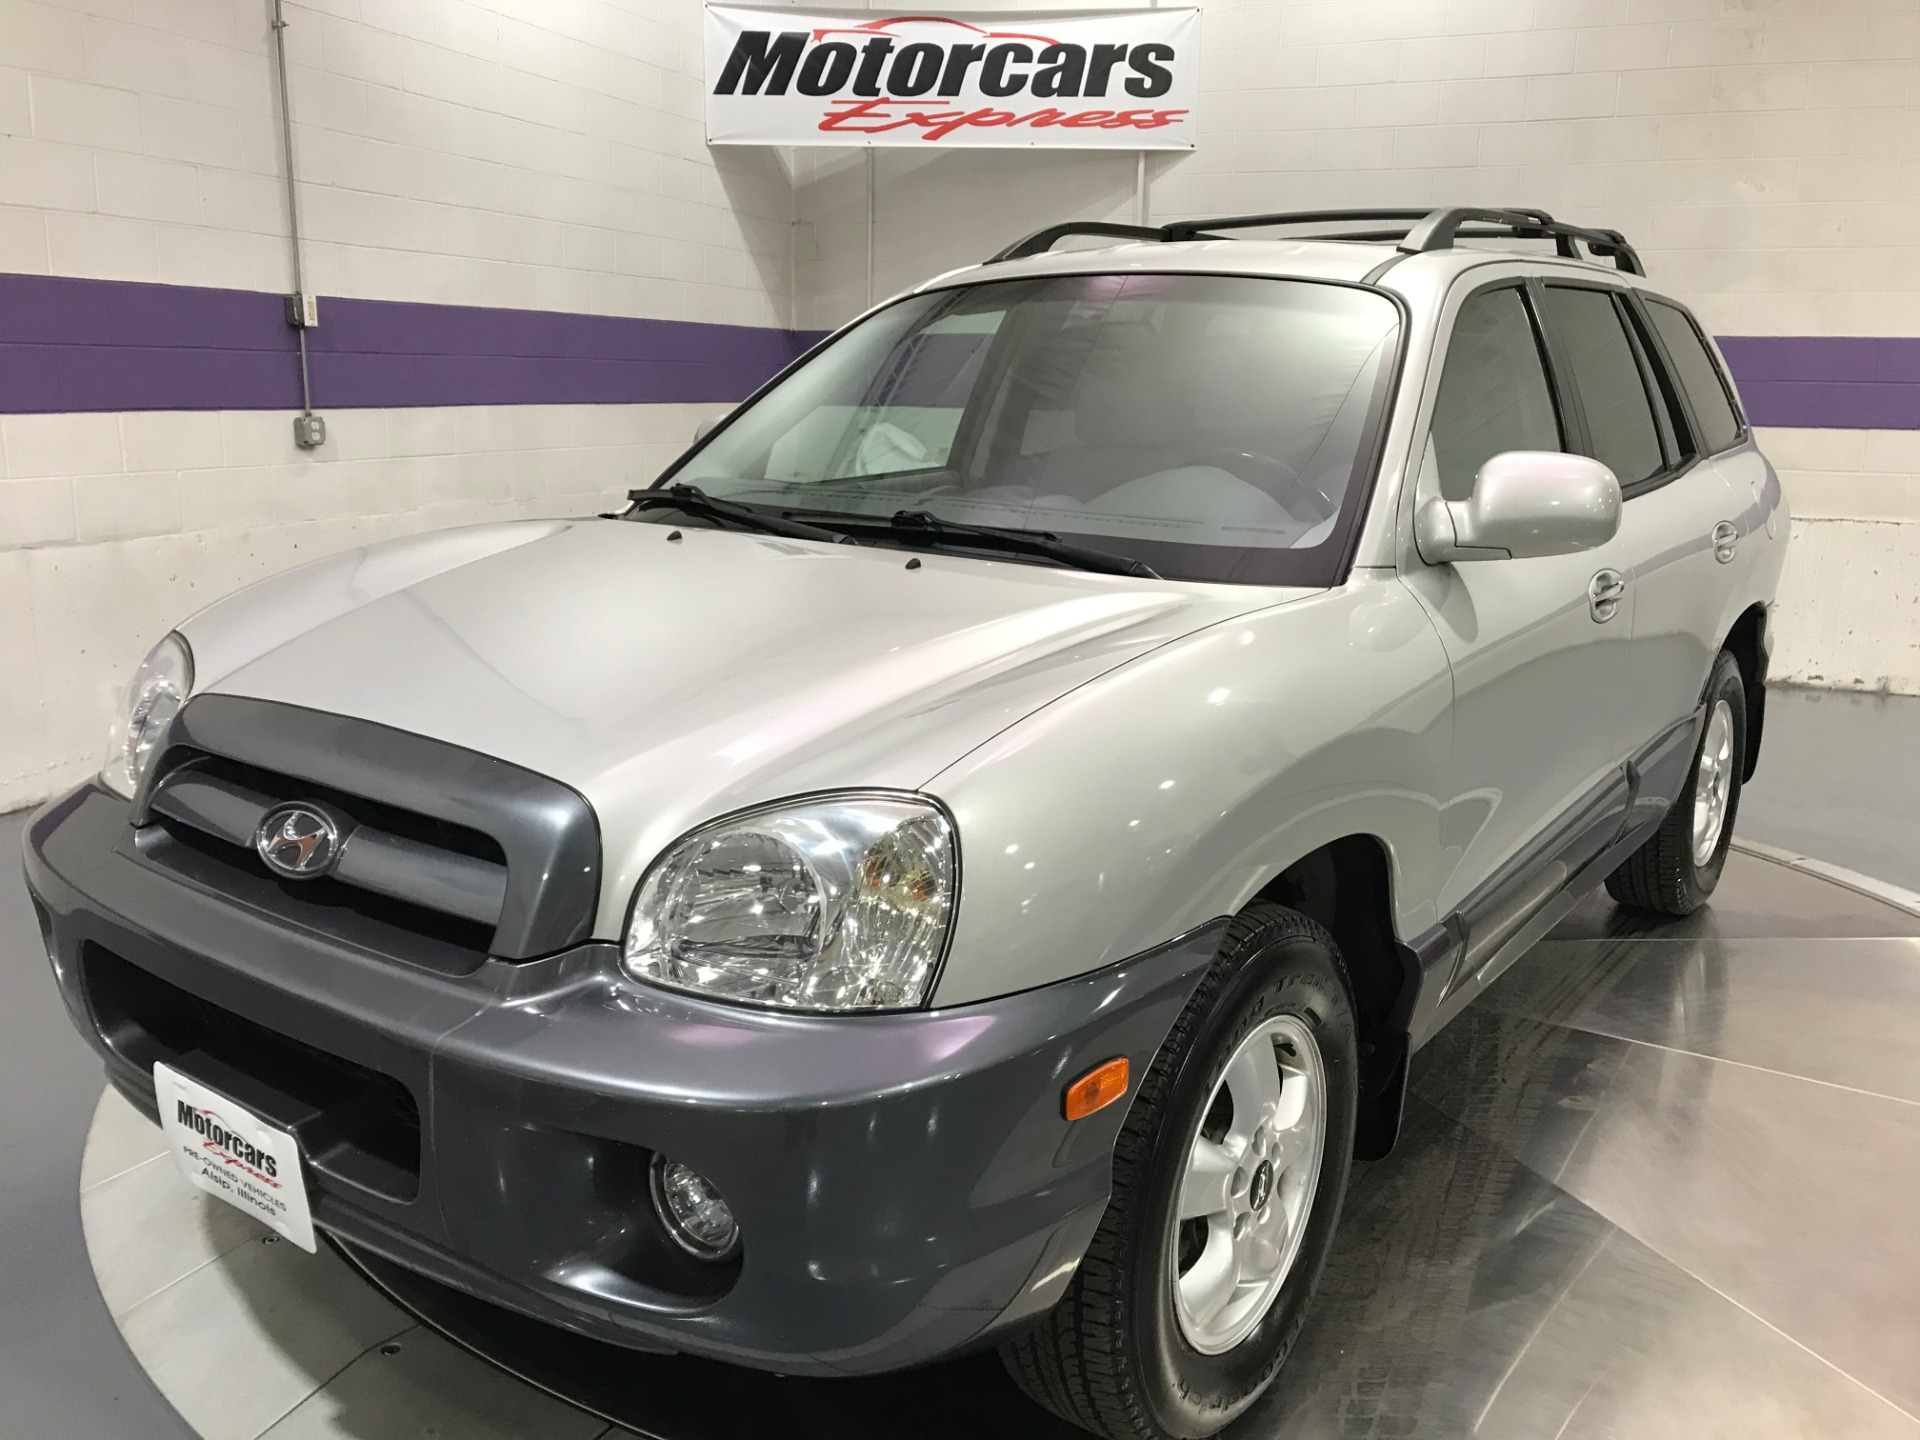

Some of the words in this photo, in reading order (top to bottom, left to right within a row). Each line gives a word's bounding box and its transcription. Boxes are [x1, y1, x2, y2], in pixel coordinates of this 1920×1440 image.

[713, 30, 1175, 98] Motorcars
[818, 97, 1189, 140] Express
[177, 1100, 277, 1178] Motorcars
[203, 1139, 282, 1189] Express
[183, 1145, 239, 1183] PRE-OWNED
[240, 1178, 287, 1211] VEHICLES
[237, 1187, 276, 1216] Illinois
